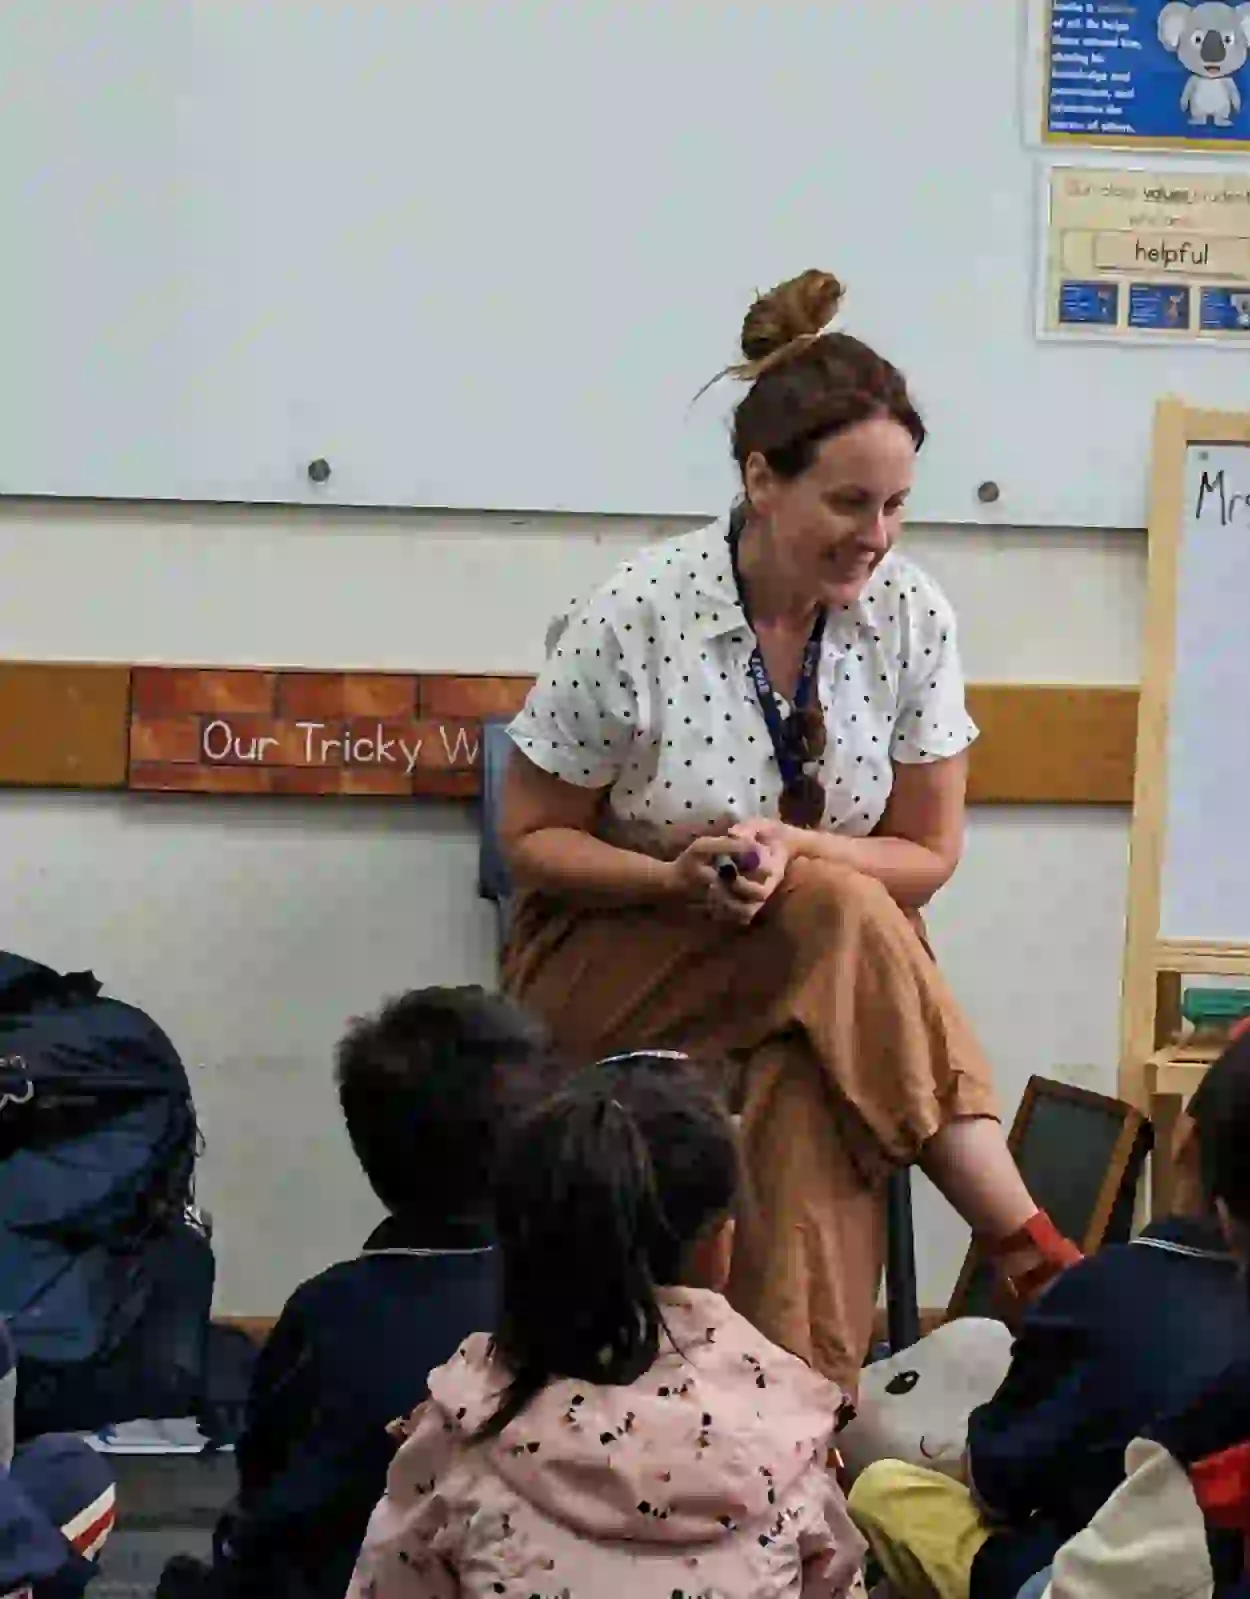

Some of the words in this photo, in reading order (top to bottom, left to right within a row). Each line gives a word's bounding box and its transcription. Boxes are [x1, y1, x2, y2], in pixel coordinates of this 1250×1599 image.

[1135, 239, 1209, 267] helpful
[203, 719, 280, 762] Our
[296, 723, 423, 774] Tricky
